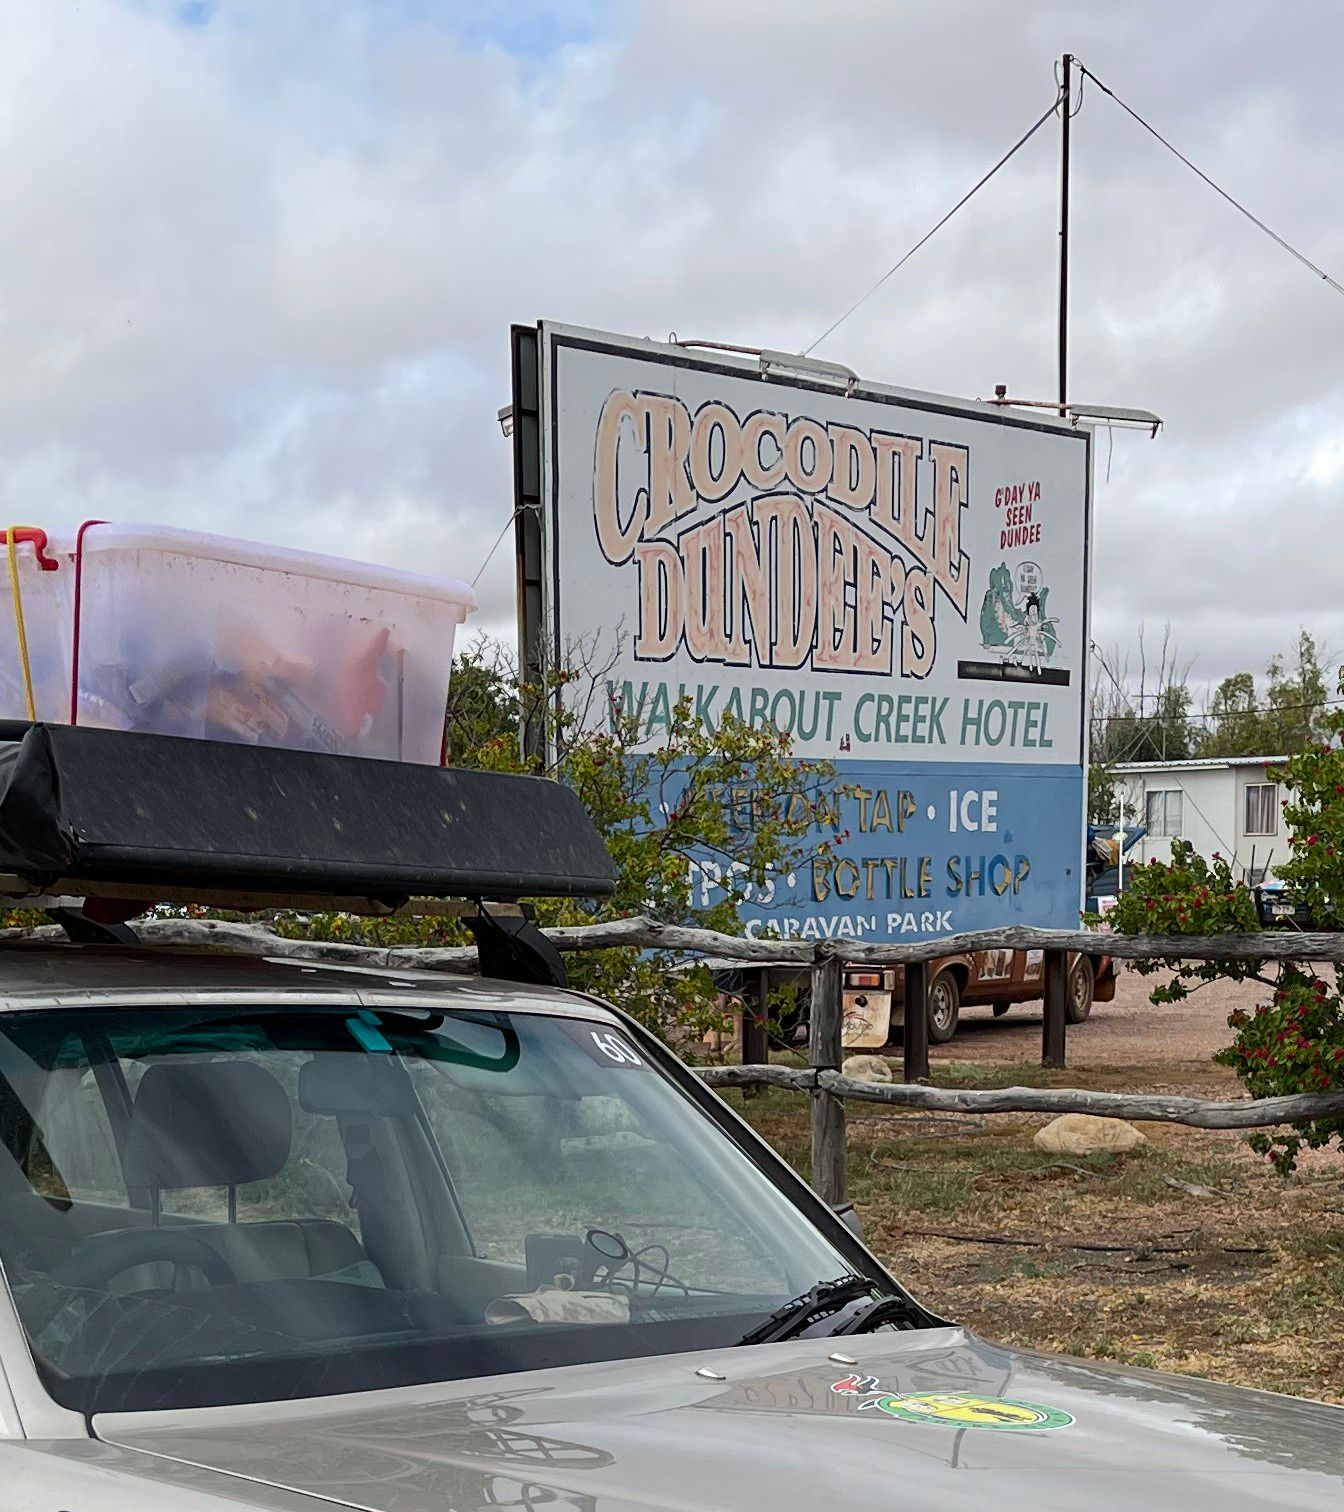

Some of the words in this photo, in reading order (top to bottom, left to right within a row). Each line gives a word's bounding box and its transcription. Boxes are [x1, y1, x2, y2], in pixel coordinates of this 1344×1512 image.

[593, 388, 970, 622] CROCODILE
[995, 481, 1026, 508] G'DAY
[1027, 480, 1042, 502] YA
[1006, 502, 1033, 528] SEEN
[1000, 523, 1042, 550] DUNDEE
[633, 491, 937, 680] DUNDEE'S
[854, 692, 951, 747] CREEK
[959, 697, 1053, 749] HOTEL
[854, 788, 918, 833] TAP
[948, 790, 999, 833] ICE
[812, 855, 933, 903] BOTTLE
[946, 854, 1032, 898] SHOP
[743, 912, 877, 941] CARAVAN
[887, 909, 954, 935] PARK
[590, 1031, 643, 1067] 60
